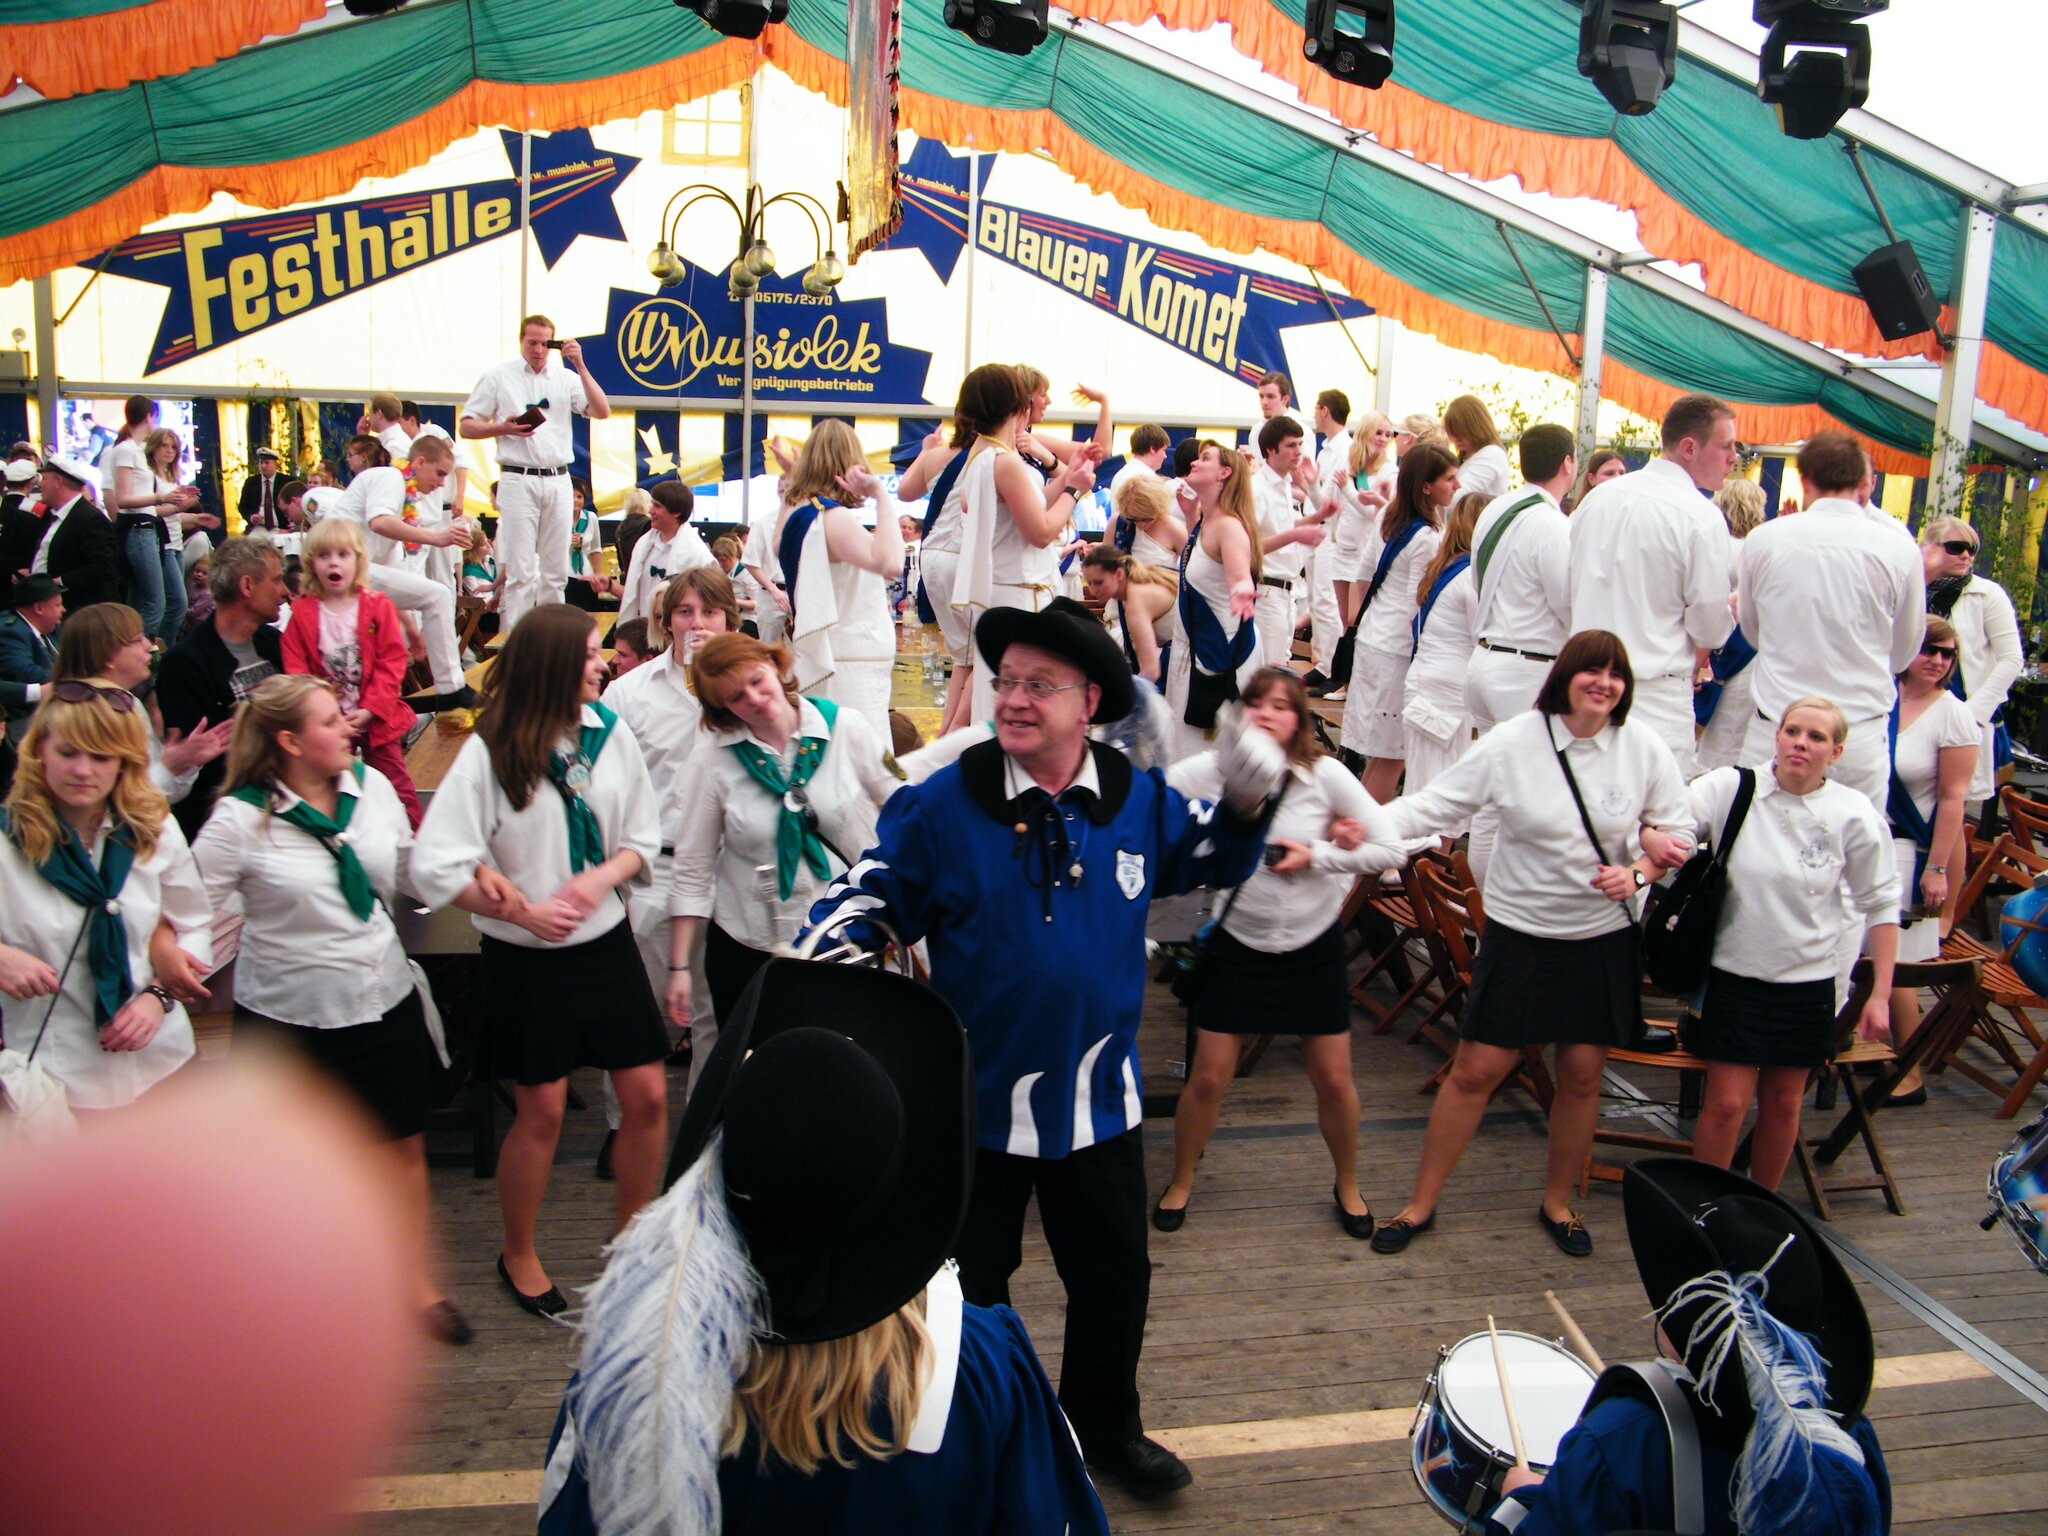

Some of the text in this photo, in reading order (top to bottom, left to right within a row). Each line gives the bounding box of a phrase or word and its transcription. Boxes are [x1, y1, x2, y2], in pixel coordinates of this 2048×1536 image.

[515, 171, 545, 184] ww.
[593, 157, 614, 167] com
[183, 190, 512, 350] Festhalle
[978, 204, 1249, 372] Blauer Komet
